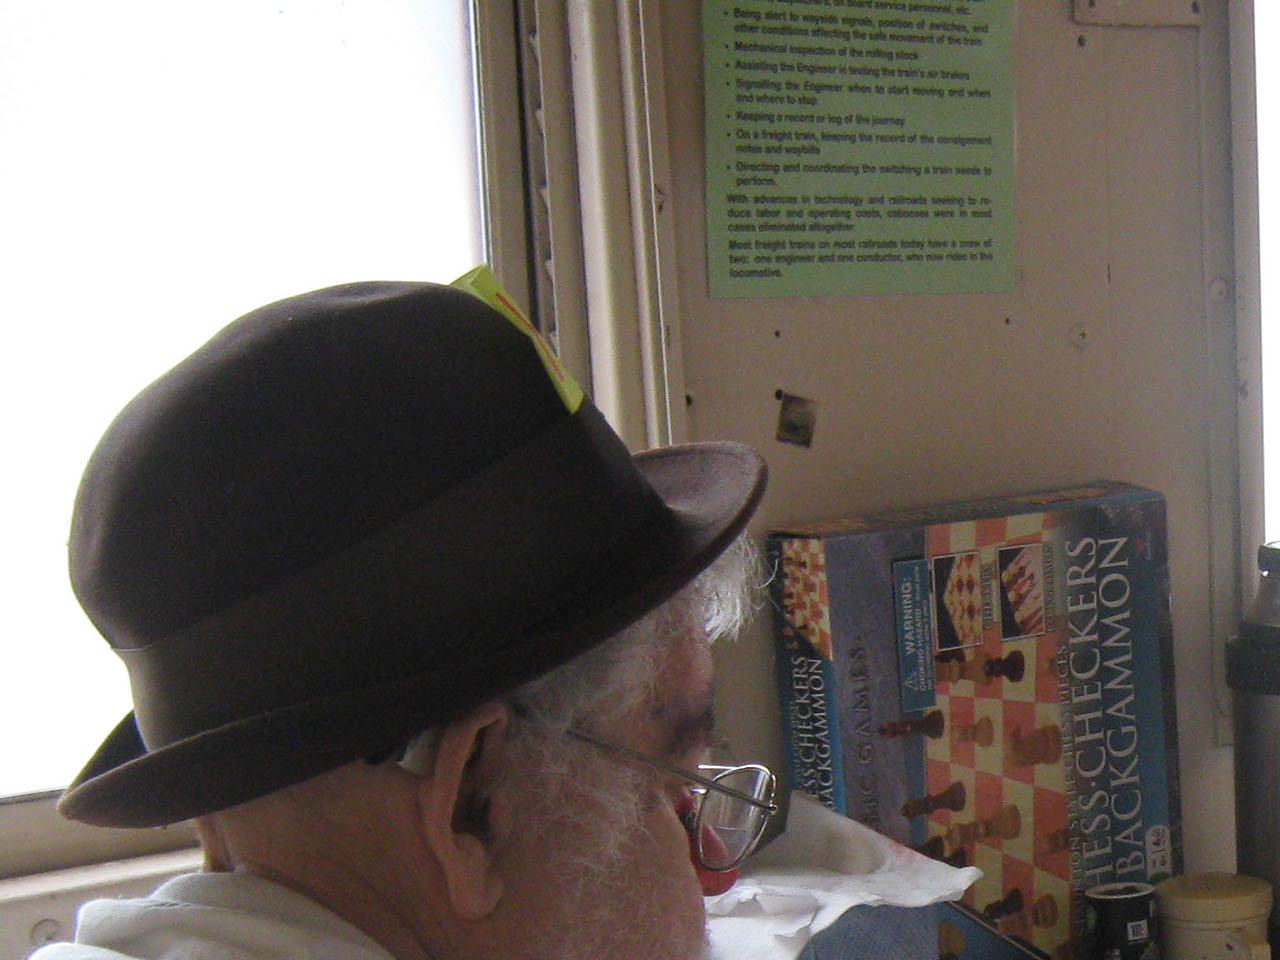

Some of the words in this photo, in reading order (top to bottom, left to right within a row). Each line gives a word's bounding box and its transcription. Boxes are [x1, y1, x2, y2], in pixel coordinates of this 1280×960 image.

[790, 11, 799, 21] to
[916, 19, 925, 30] of
[972, 24, 988, 33] and
[761, 25, 809, 36] conditions
[852, 30, 866, 40] the
[936, 35, 945, 44] of
[947, 35, 961, 45] the
[838, 47, 846, 56] of
[850, 47, 863, 57] the
[780, 63, 794, 71] the
[882, 67, 895, 77] the
[785, 80, 800, 90] the
[875, 85, 885, 94] to
[887, 85, 909, 95] start
[912, 87, 945, 98] moving
[948, 89, 964, 97] and
[967, 89, 991, 97] when
[756, 94, 785, 104] where
[787, 95, 796, 104] to
[735, 111, 775, 124] Keeping
[784, 114, 814, 122] record
[828, 114, 841, 125] log
[844, 114, 853, 123] of
[855, 114, 870, 125] the
[736, 129, 751, 139] On
[762, 130, 792, 142] freight
[859, 132, 873, 143] the
[875, 134, 905, 143] record
[907, 134, 916, 143] of
[919, 134, 934, 144] the
[765, 145, 782, 154] and
[736, 161, 780, 175] Directing
[783, 164, 800, 173] and
[803, 164, 859, 175] coordinating
[862, 164, 876, 173] the
[924, 166, 930, 174] a
[933, 165, 953, 175] train
[955, 165, 980, 175] needs
[983, 166, 992, 175] to
[727, 194, 749, 204] With
[753, 195, 797, 204] advances
[801, 195, 810, 204] in
[814, 195, 863, 206] technology
[868, 196, 884, 205] and
[931, 196, 964, 207] seeking
[968, 196, 976, 205] to
[728, 208, 751, 217] duce
[756, 209, 780, 217] labor
[786, 209, 804, 217] and
[808, 209, 851, 220] operating
[933, 210, 955, 218] were
[758, 222, 806, 232] eliminated
[729, 240, 751, 249] Most
[755, 240, 786, 251] freight
[789, 240, 815, 249] trains
[818, 241, 830, 249] on
[833, 240, 855, 249] most
[900, 240, 924, 250] today
[927, 240, 948, 248] have
[983, 239, 992, 248] of
[775, 255, 815, 265] engineer
[946, 253, 967, 261] rides
[980, 252, 993, 261] the
[901, 577, 916, 656] WARNING:
[914, 608, 925, 647] HAZARD
[917, 648, 928, 692] CHOKING
[1098, 535, 1146, 878] BACKGAMMON
